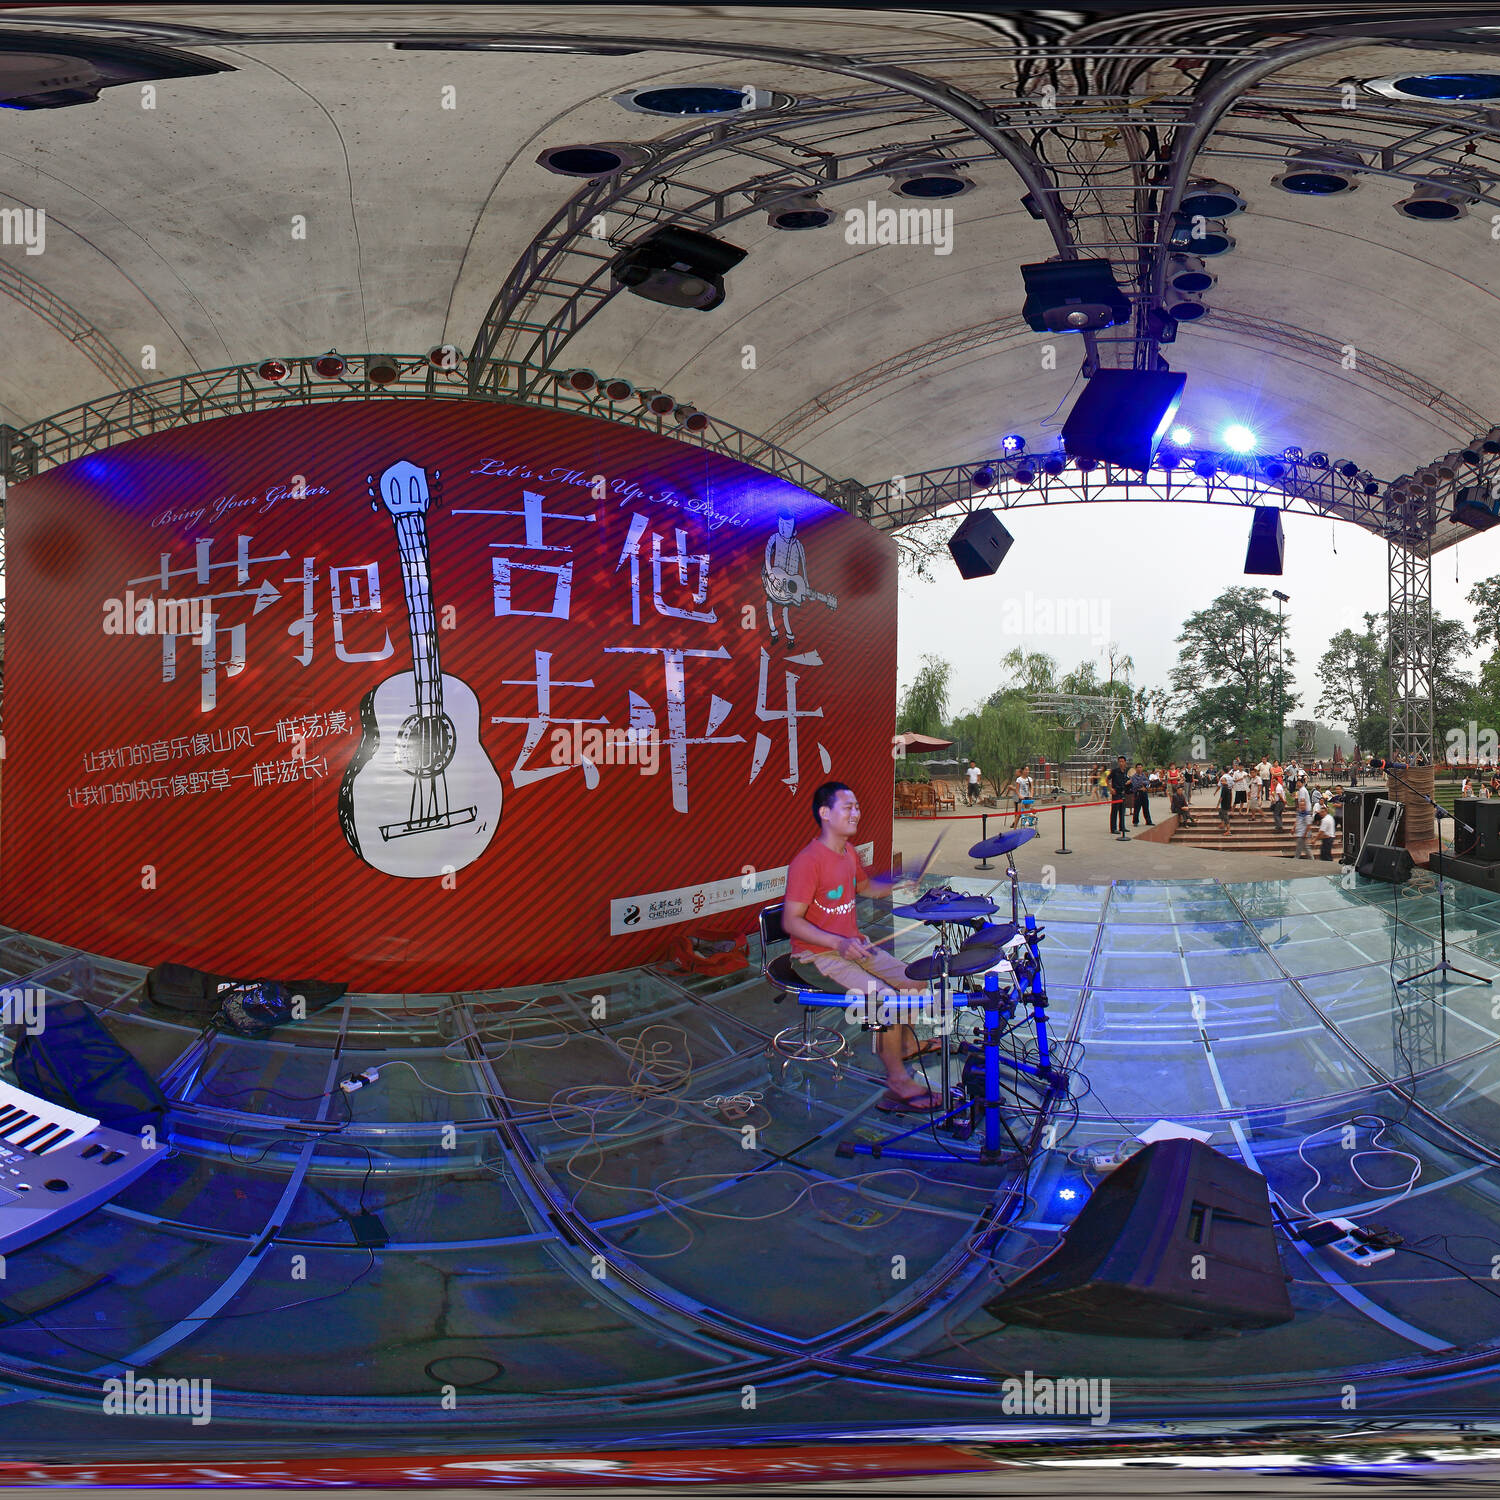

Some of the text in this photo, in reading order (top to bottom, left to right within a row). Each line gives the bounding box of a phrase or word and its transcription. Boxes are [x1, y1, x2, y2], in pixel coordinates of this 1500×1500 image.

[152, 506, 206, 531] Bring
[209, 494, 258, 524] Your
[470, 458, 750, 531] Let's Meet Up In Pingle!
[127, 490, 717, 712] 带把 吉他
[491, 645, 831, 814] 去平乐
[648, 906, 682, 919] CHENGDU
